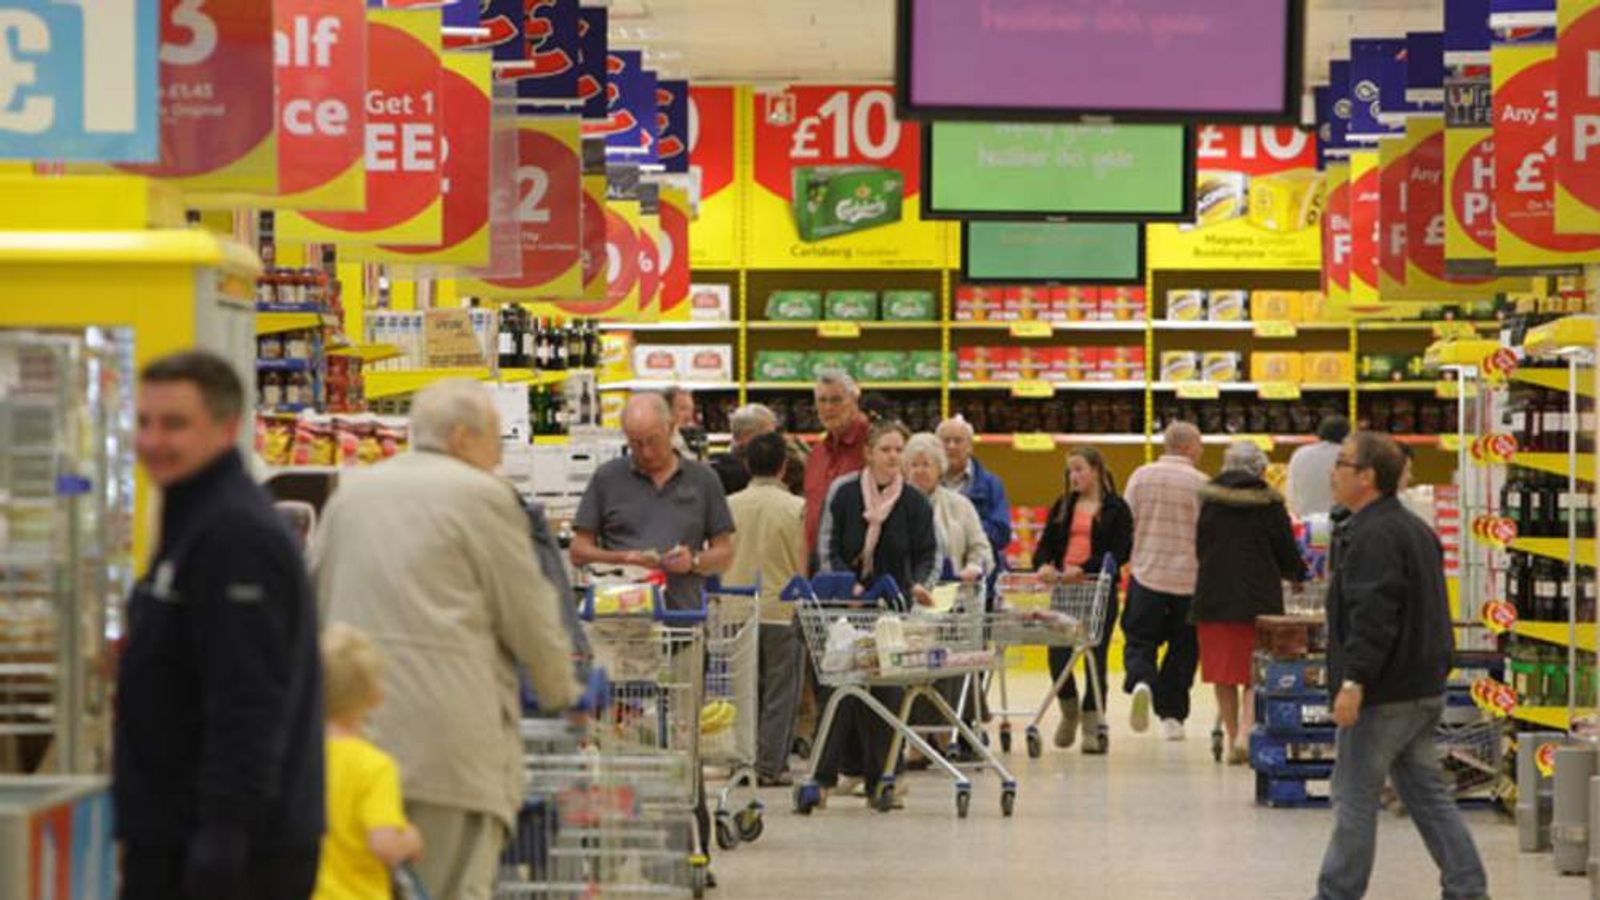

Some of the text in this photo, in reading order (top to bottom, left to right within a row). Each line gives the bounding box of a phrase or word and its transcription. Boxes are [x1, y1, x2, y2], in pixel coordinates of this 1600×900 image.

[0, 0, 137, 134] £1
[365, 89, 435, 115] Get 1
[789, 90, 901, 159] £10
[1502, 104, 1540, 125] Any
